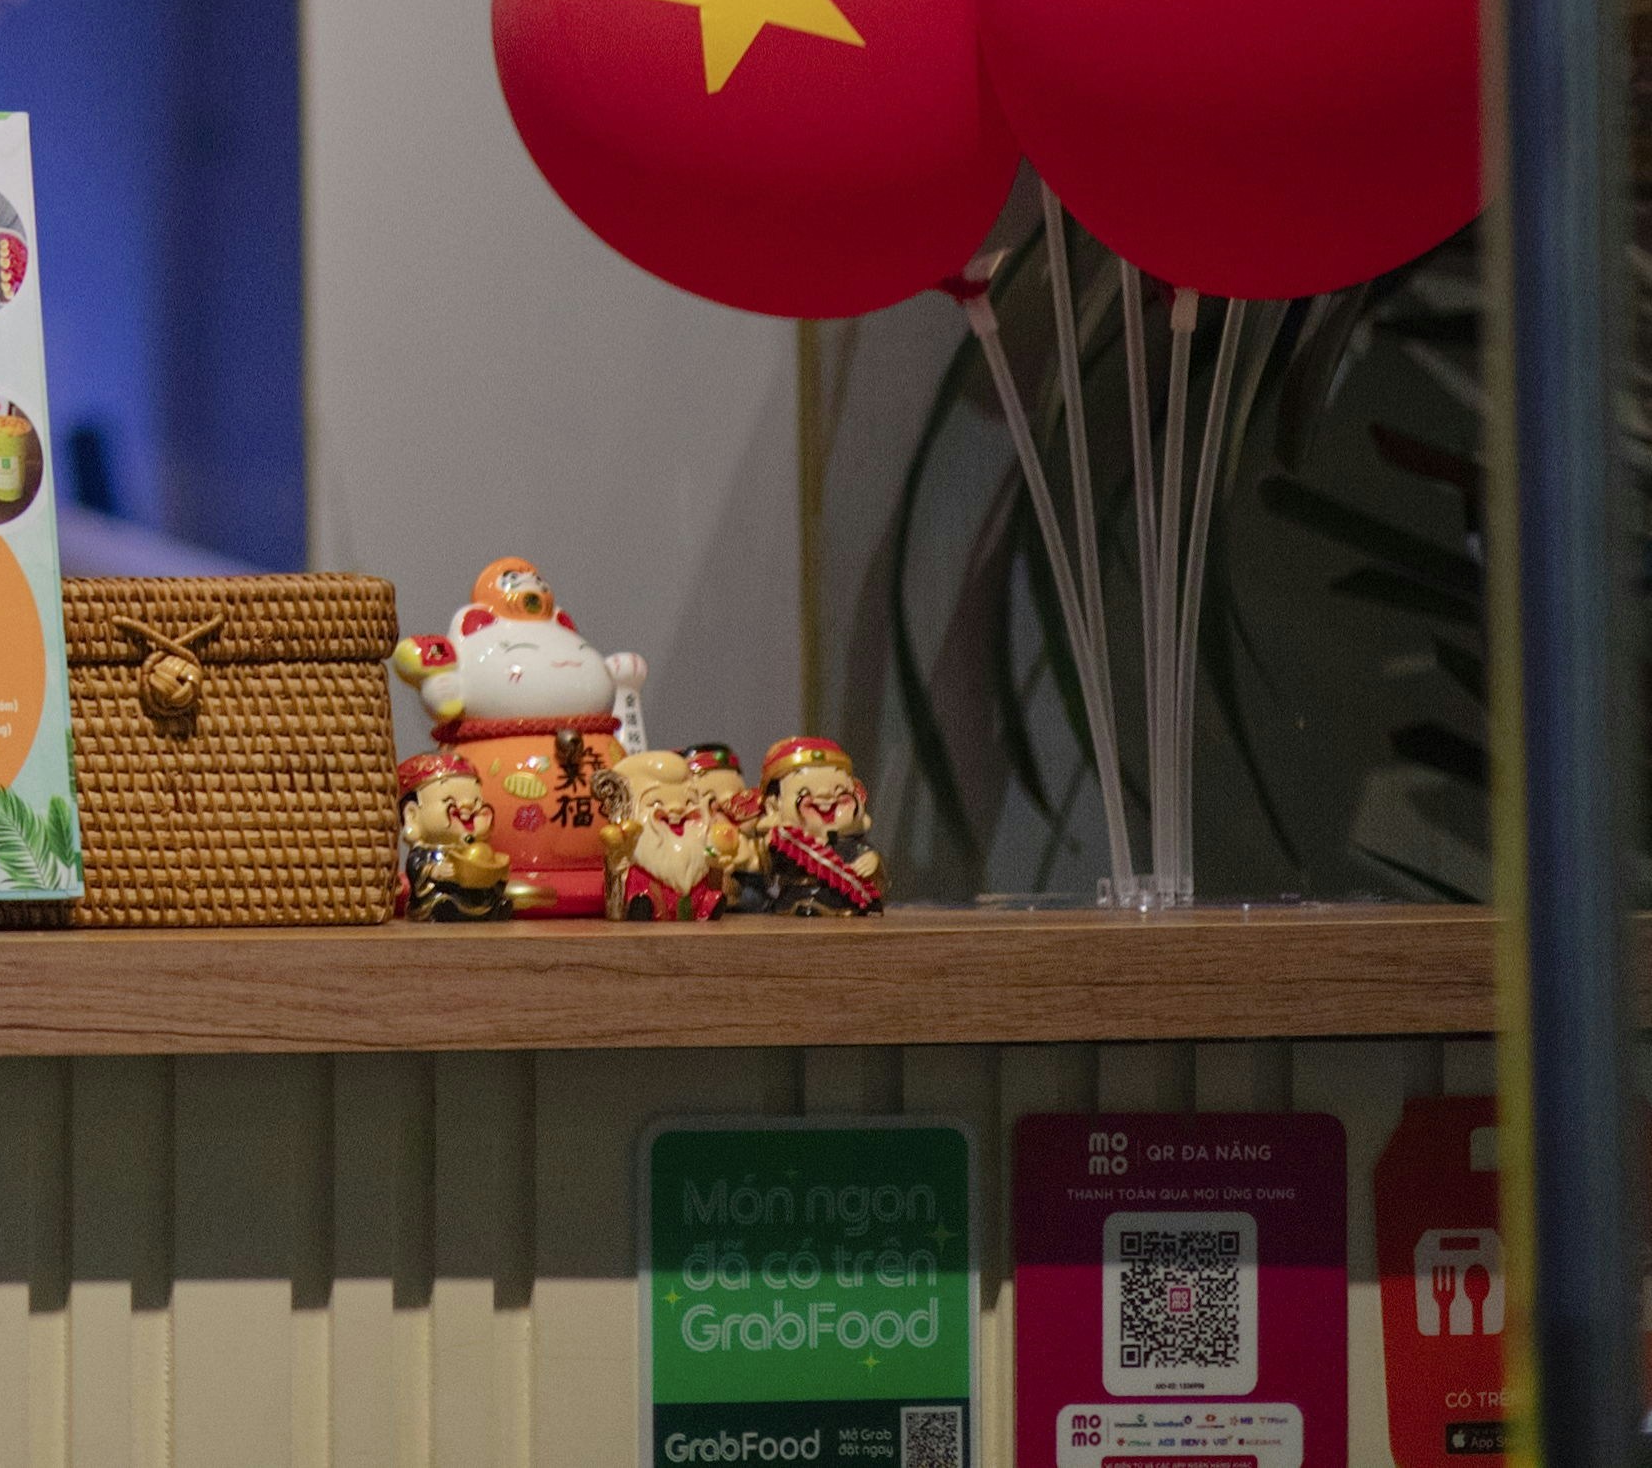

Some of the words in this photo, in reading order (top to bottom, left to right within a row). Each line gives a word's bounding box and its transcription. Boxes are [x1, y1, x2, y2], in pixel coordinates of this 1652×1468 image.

[1146, 1145, 1174, 1162] QR
[1181, 1145, 1209, 1161] ĐA
[1215, 1141, 1272, 1161] NĂNG
[1067, 1189, 1114, 1200] THANH
[1118, 1185, 1156, 1200] TOÁN
[1160, 1189, 1189, 1201] QUA
[683, 1174, 794, 1226] Món
[805, 1183, 936, 1236] ngon
[682, 1240, 751, 1291] đã
[762, 1239, 822, 1290] có
[835, 1238, 937, 1287] trên
[681, 1297, 939, 1352] GrabFood
[1445, 1389, 1470, 1409] CÓ
[664, 1429, 821, 1462] GrabFood
[861, 1428, 893, 1442] Grab
[862, 1443, 893, 1458] ngay
